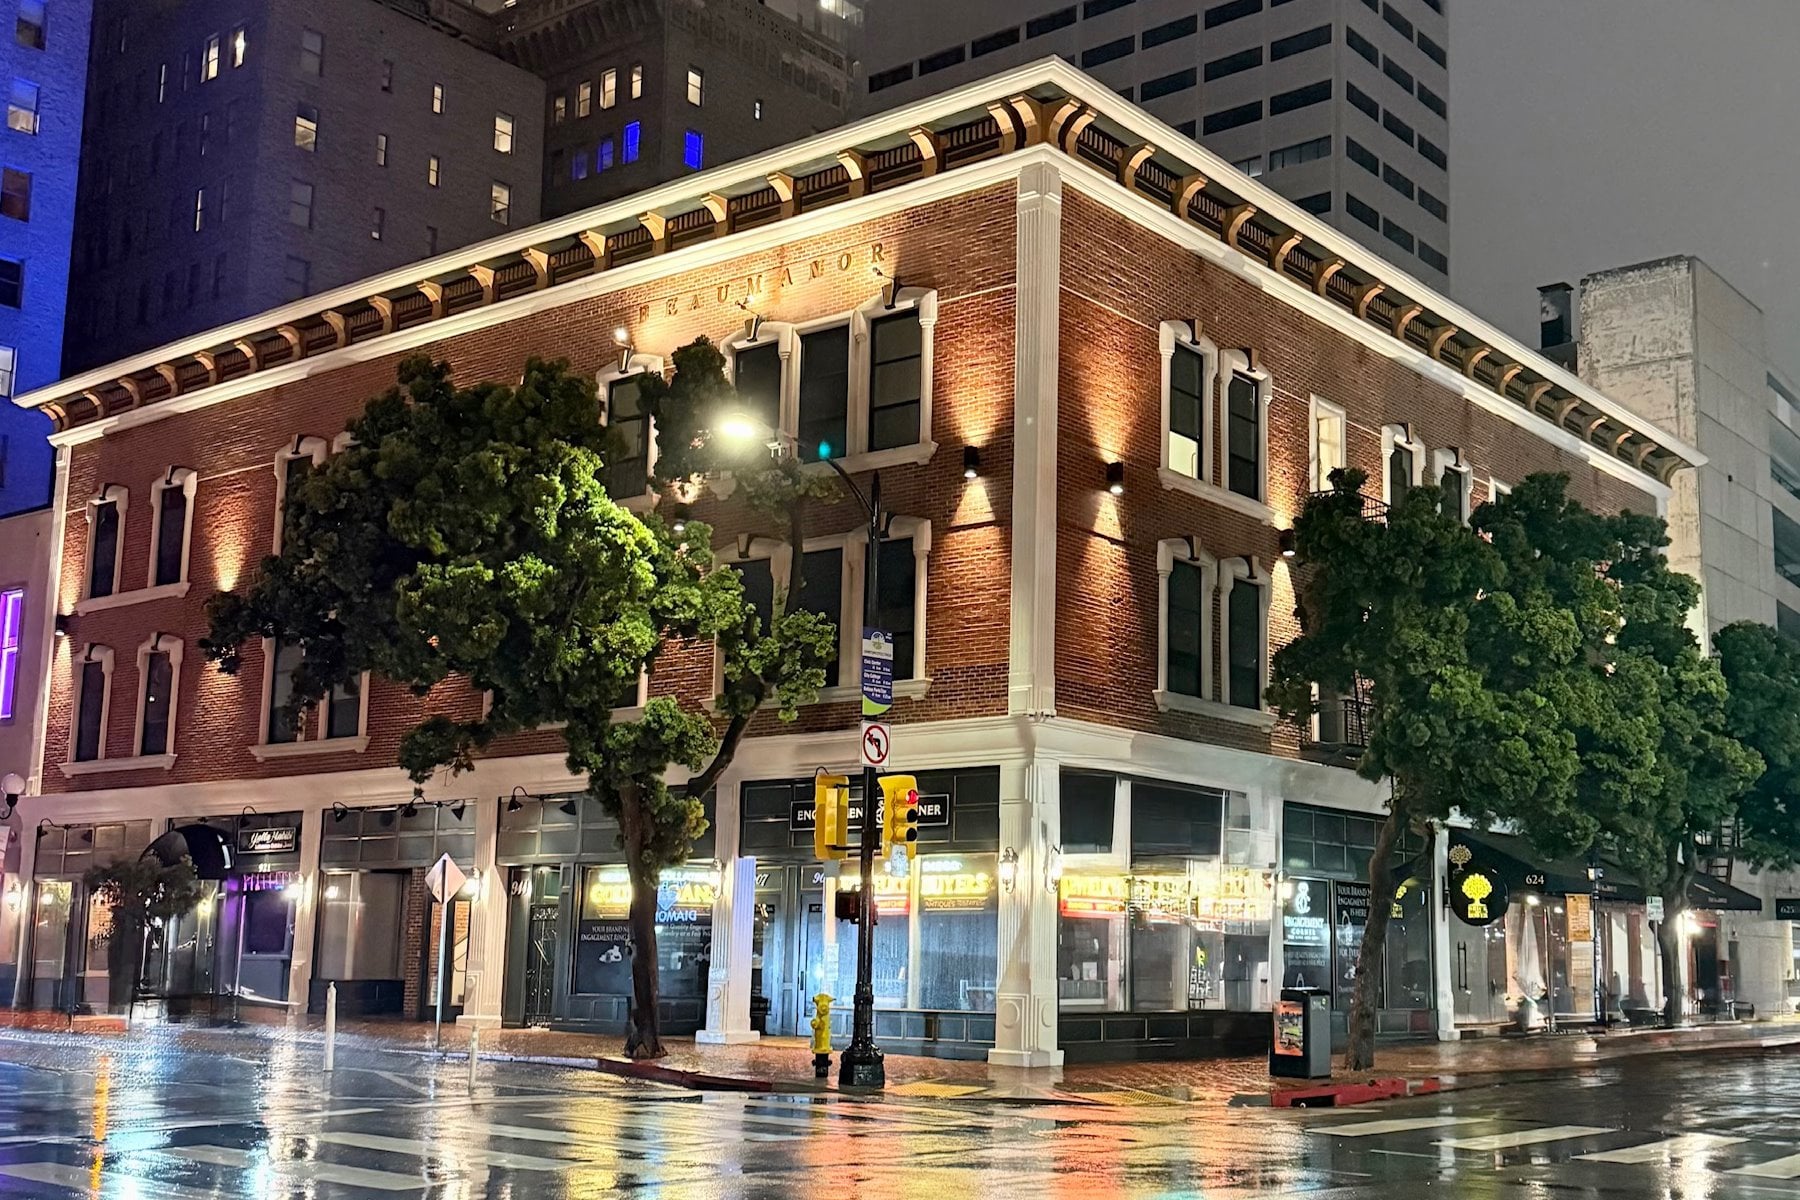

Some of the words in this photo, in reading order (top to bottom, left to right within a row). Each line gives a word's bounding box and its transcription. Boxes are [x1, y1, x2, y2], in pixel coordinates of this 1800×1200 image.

[638, 242, 885, 324] BEAUMANOR
[258, 863, 271, 873] 921
[756, 873, 770, 887] 07
[1525, 874, 1545, 885] 624
[1284, 916, 1325, 928] ENGAGEMENT
